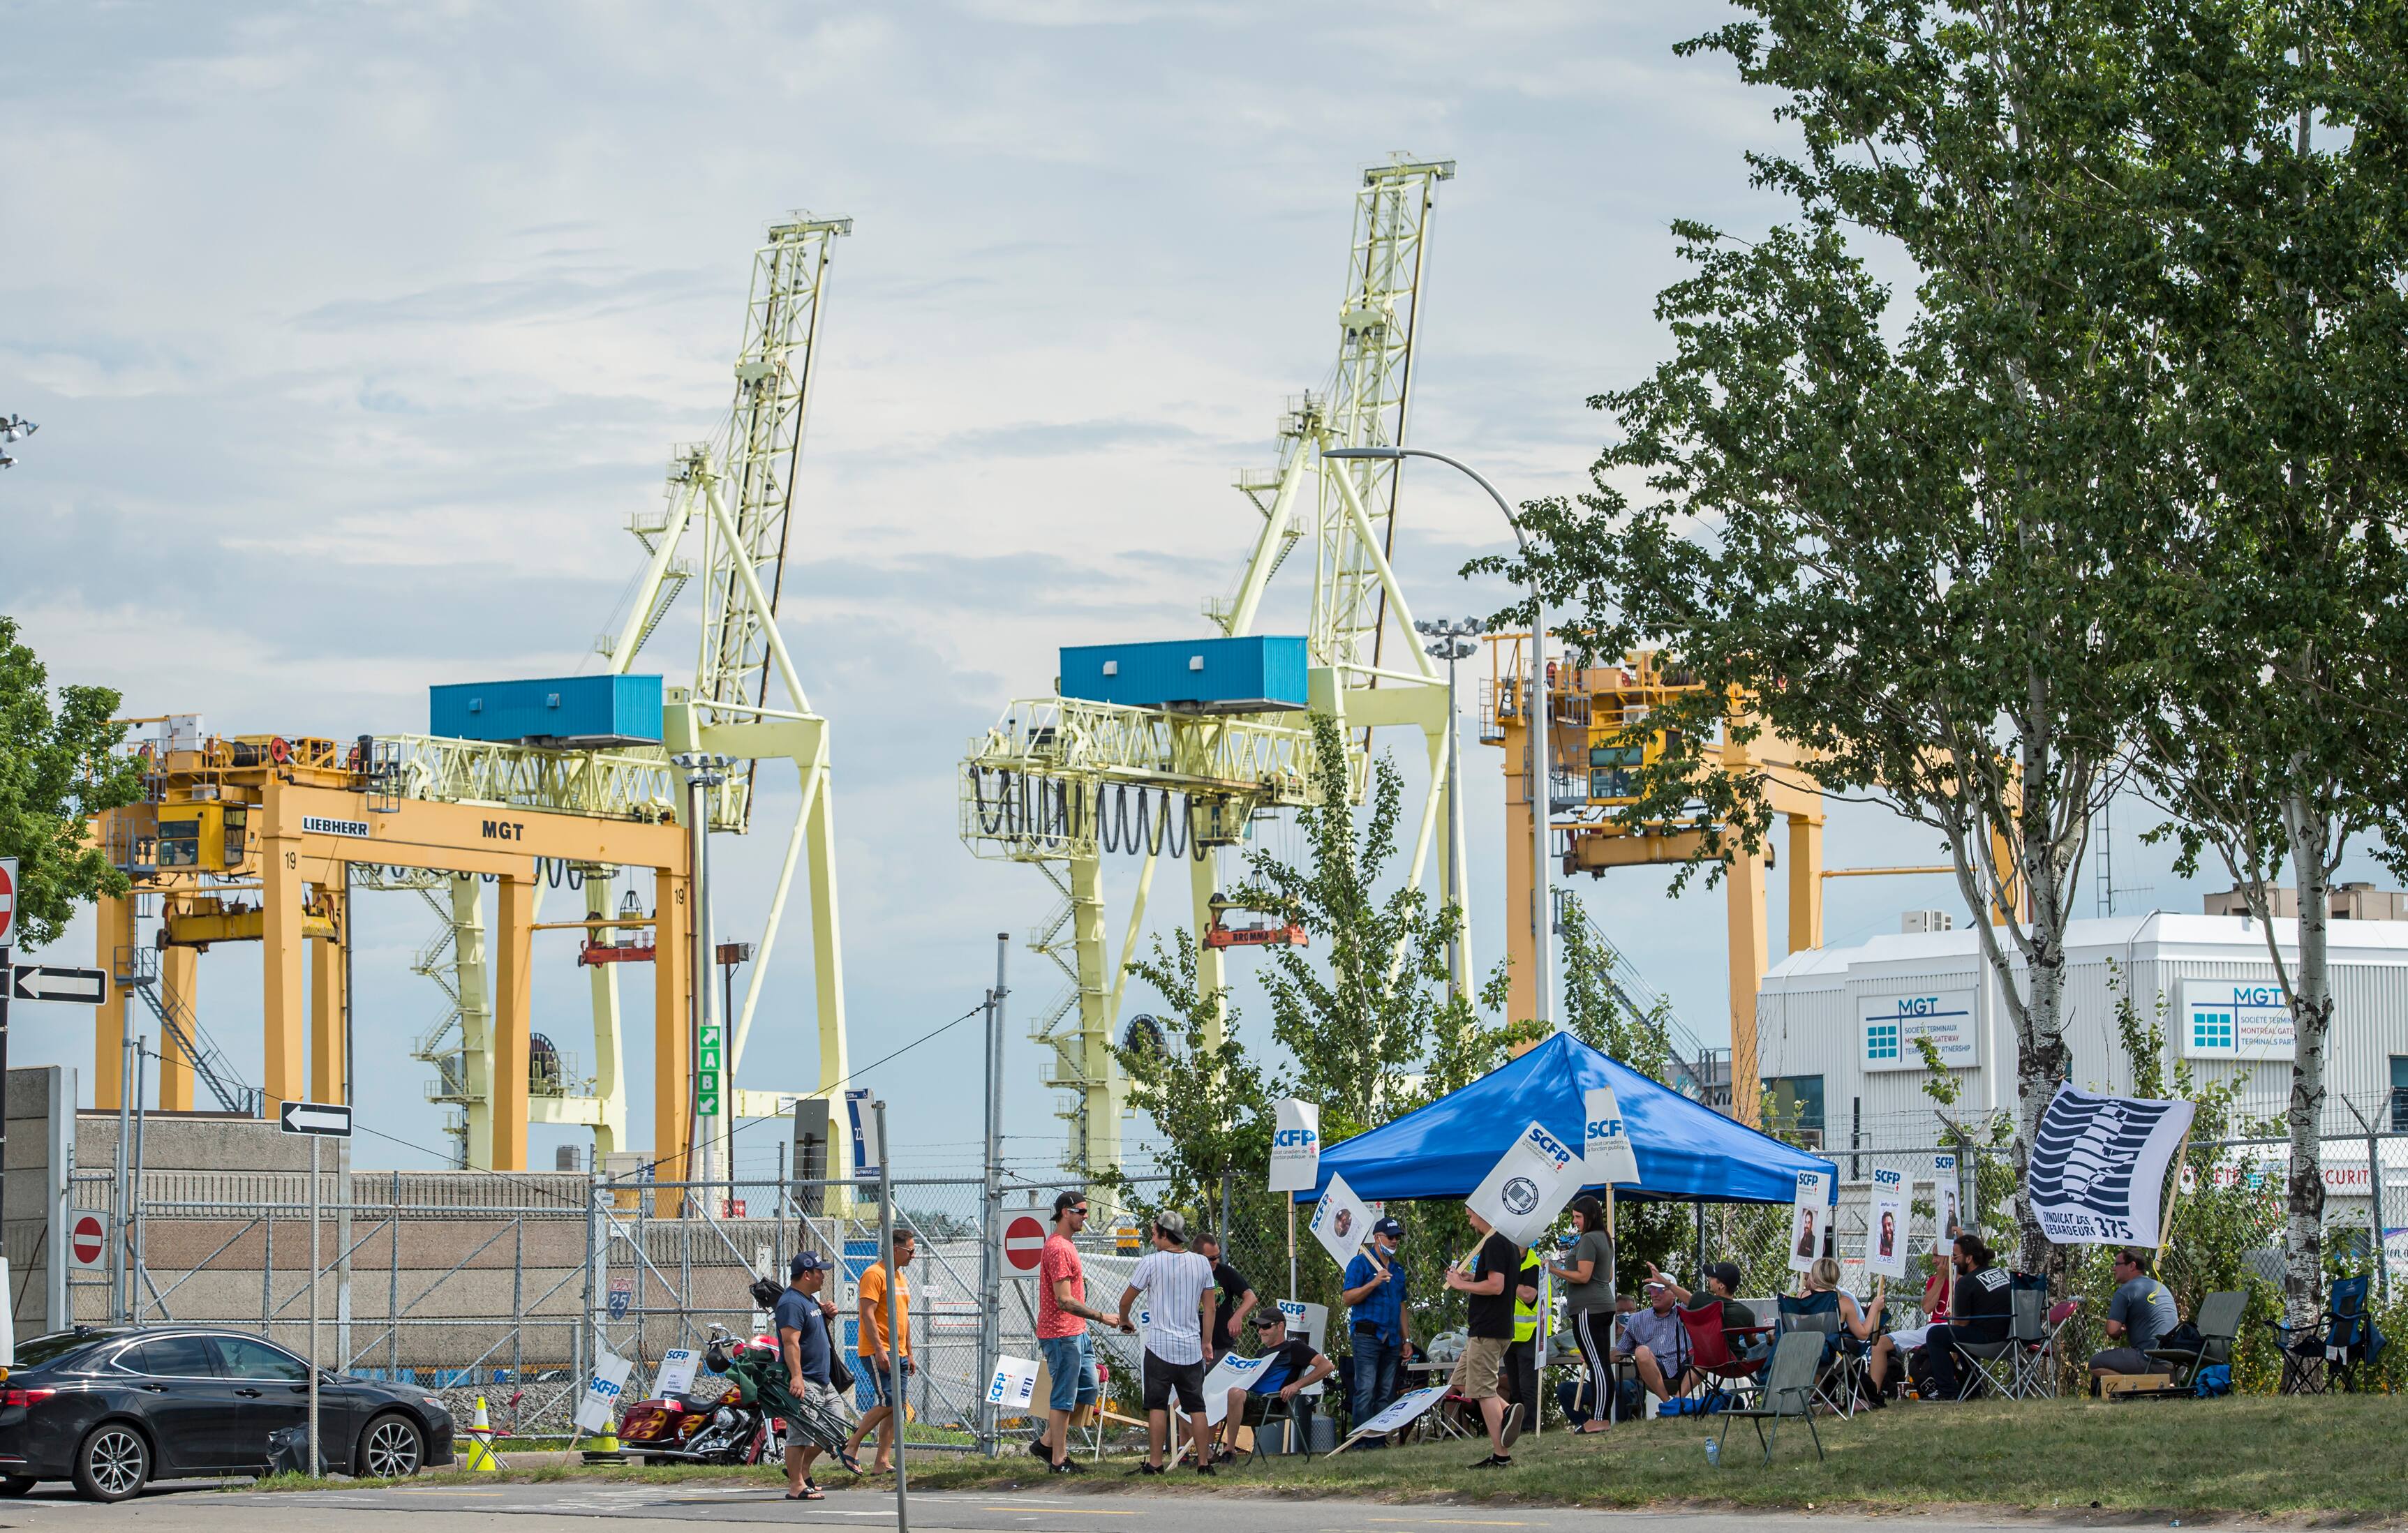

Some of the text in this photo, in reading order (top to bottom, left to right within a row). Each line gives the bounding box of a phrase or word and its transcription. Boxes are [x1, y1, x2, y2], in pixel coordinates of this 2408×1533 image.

[303, 817, 368, 836] LIEBHERR
[482, 821, 524, 841] MGT
[285, 851, 297, 870] 19
[674, 888, 685, 905] 19
[2234, 987, 2283, 1005] MGT
[1898, 998, 1938, 1015] MGT
[1927, 1024, 1957, 1033] TERMINAUX
[705, 1052, 716, 1067] A
[702, 1075, 713, 1090] B
[1587, 1119, 1627, 1139] SCF
[1529, 1128, 1570, 1163] SCFP
[1935, 1156, 1954, 1169] SCFP
[1799, 1173, 1818, 1186] SCFP
[1875, 1169, 1900, 1184] SCFP
[1312, 1193, 1329, 1231] SCFP
[2043, 1211, 2134, 1240] SYNDICAT DES 375
[1979, 1270, 2005, 1284] VANS
[610, 1294, 627, 1310] 25
[1279, 1302, 1306, 1315] SCFP
[667, 1350, 689, 1360] SCFP
[590, 1377, 620, 1396] SCFP
[990, 1373, 1006, 1402] SCFP
